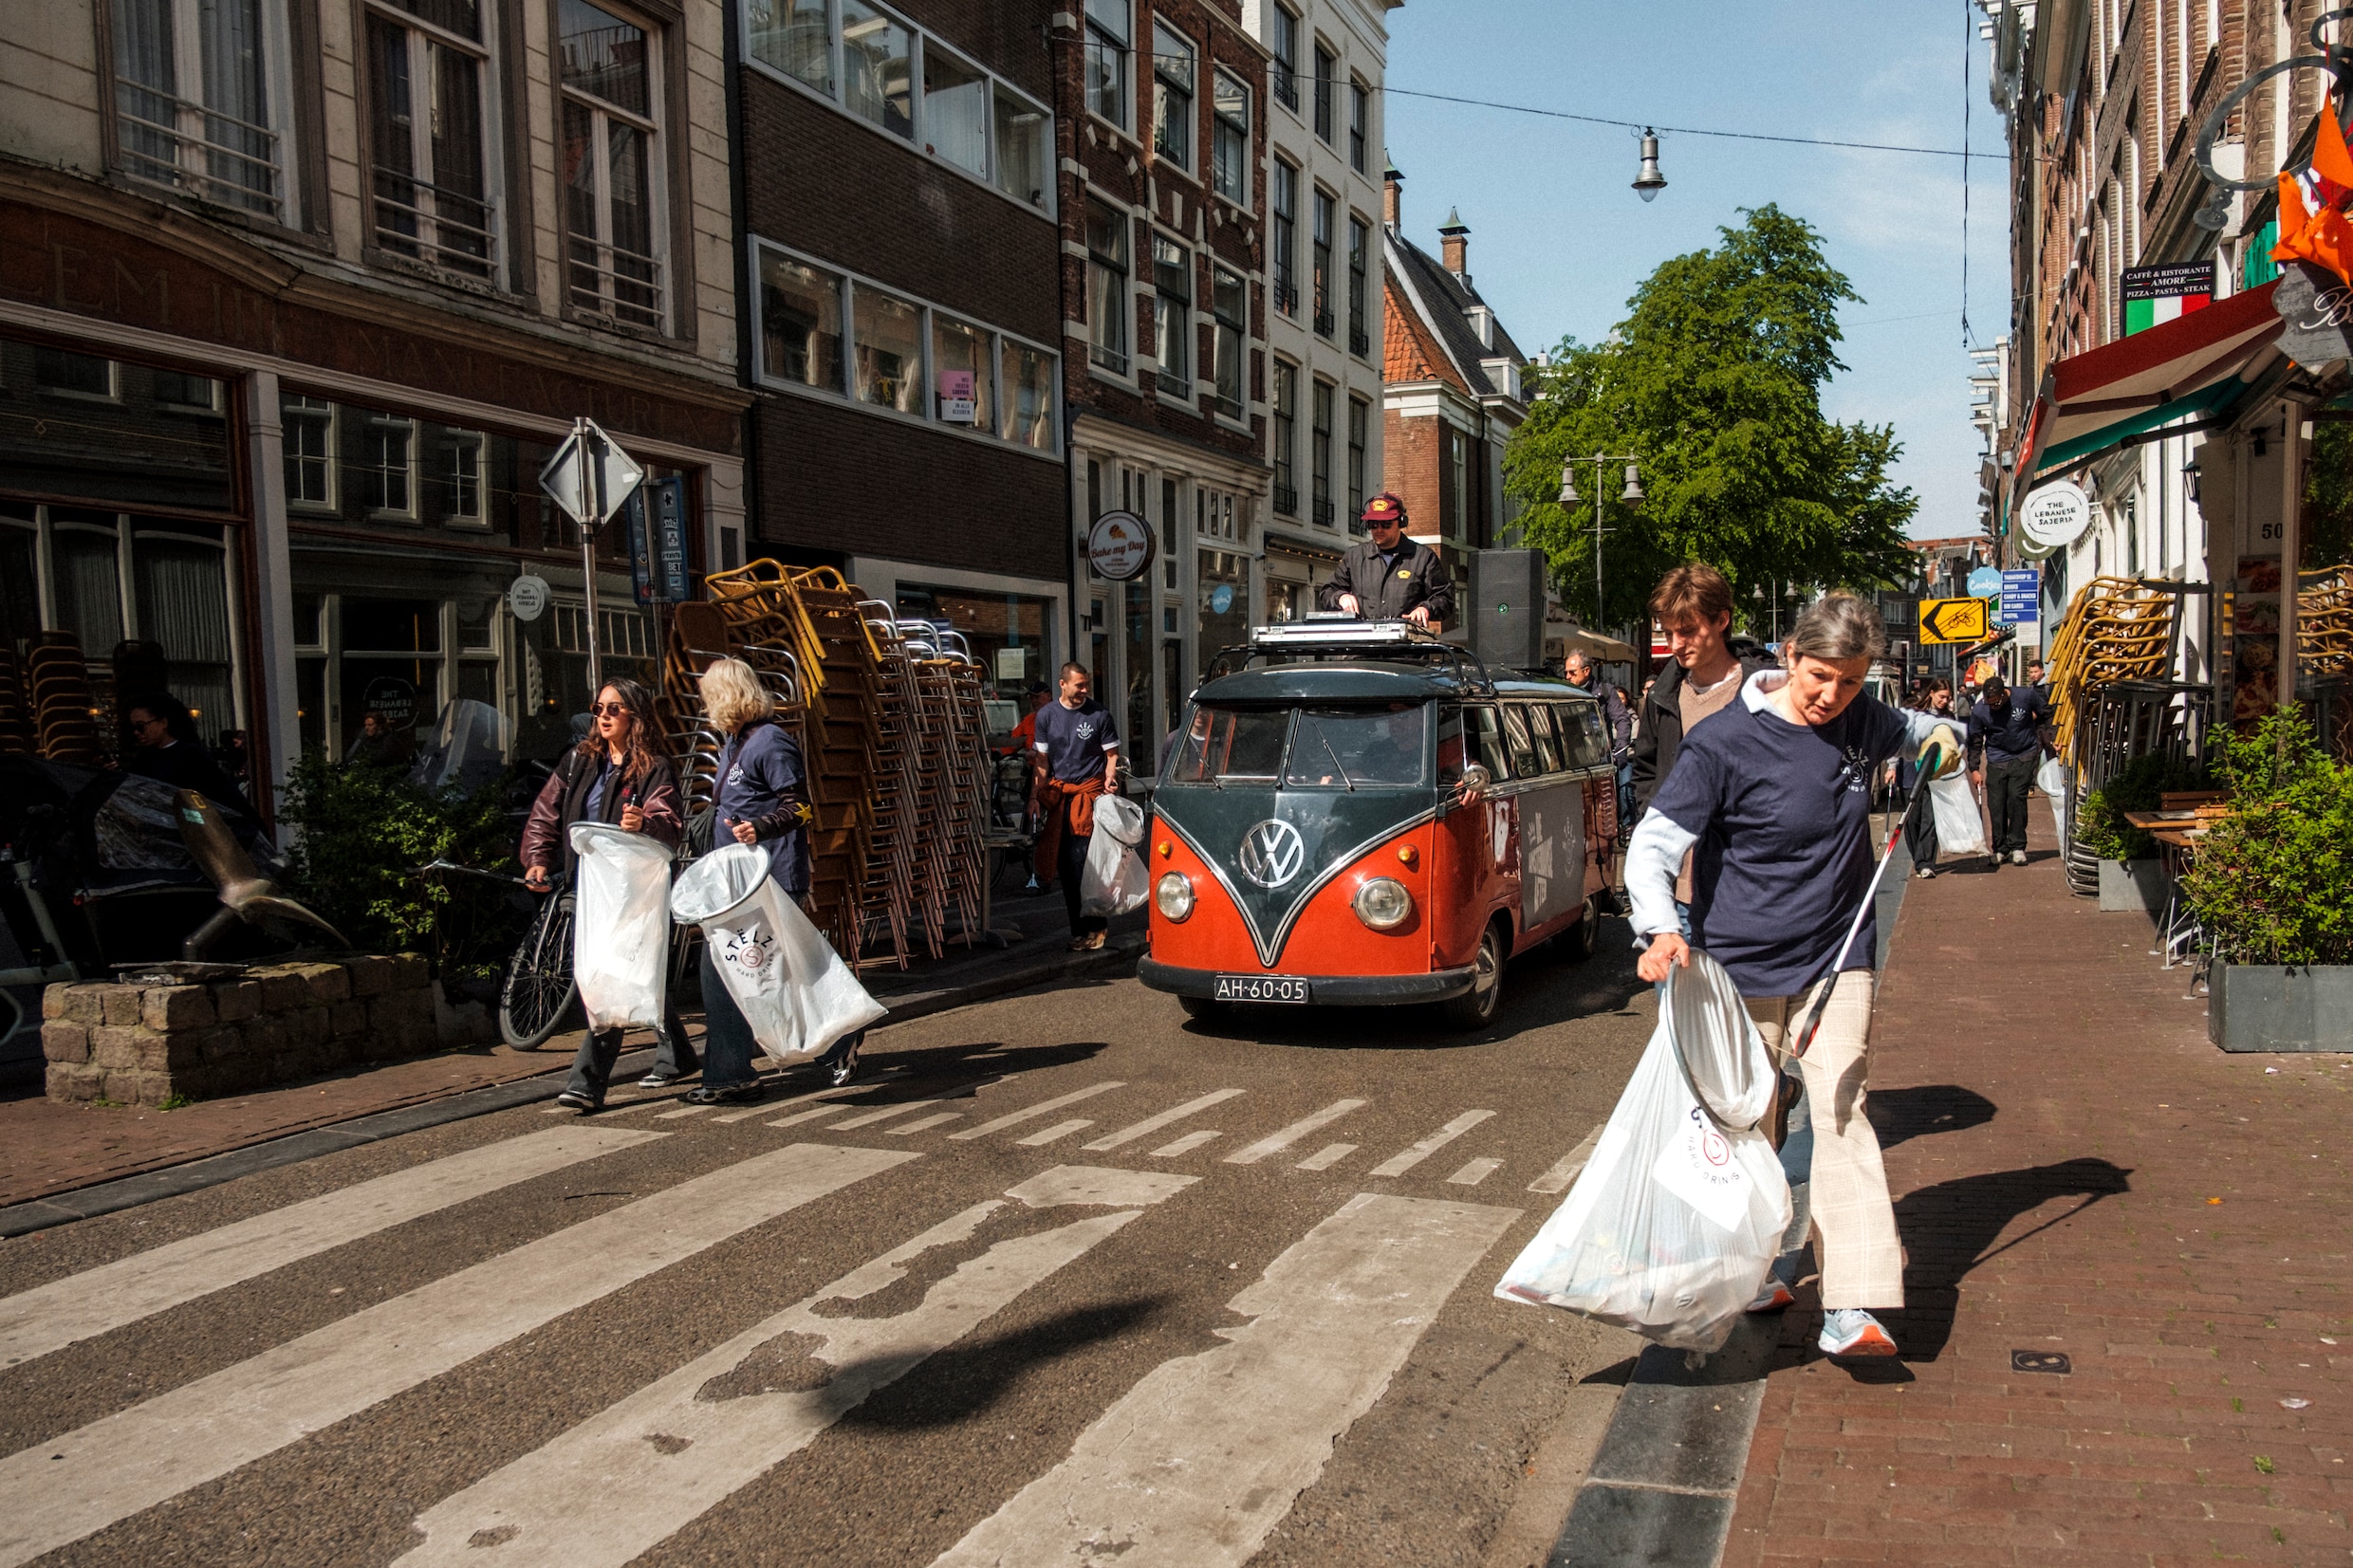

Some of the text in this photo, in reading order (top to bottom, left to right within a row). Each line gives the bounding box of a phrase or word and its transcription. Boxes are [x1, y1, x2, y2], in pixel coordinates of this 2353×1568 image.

[2126, 270, 2152, 280] CAFFÈ
[2161, 266, 2211, 276] RISTORANTE
[2151, 277, 2186, 286] AMORE
[2126, 289, 2149, 298] PIZZA
[2183, 285, 2211, 293] STEAK
[2034, 507, 2076, 517] LEBANESE
[2038, 516, 2073, 525] SAJERIA
[2262, 523, 2283, 539] 50
[1091, 541, 1145, 559] Bake my Day
[725, 928, 773, 962] STËLZ
[1216, 979, 1305, 1000] AH-60-05
